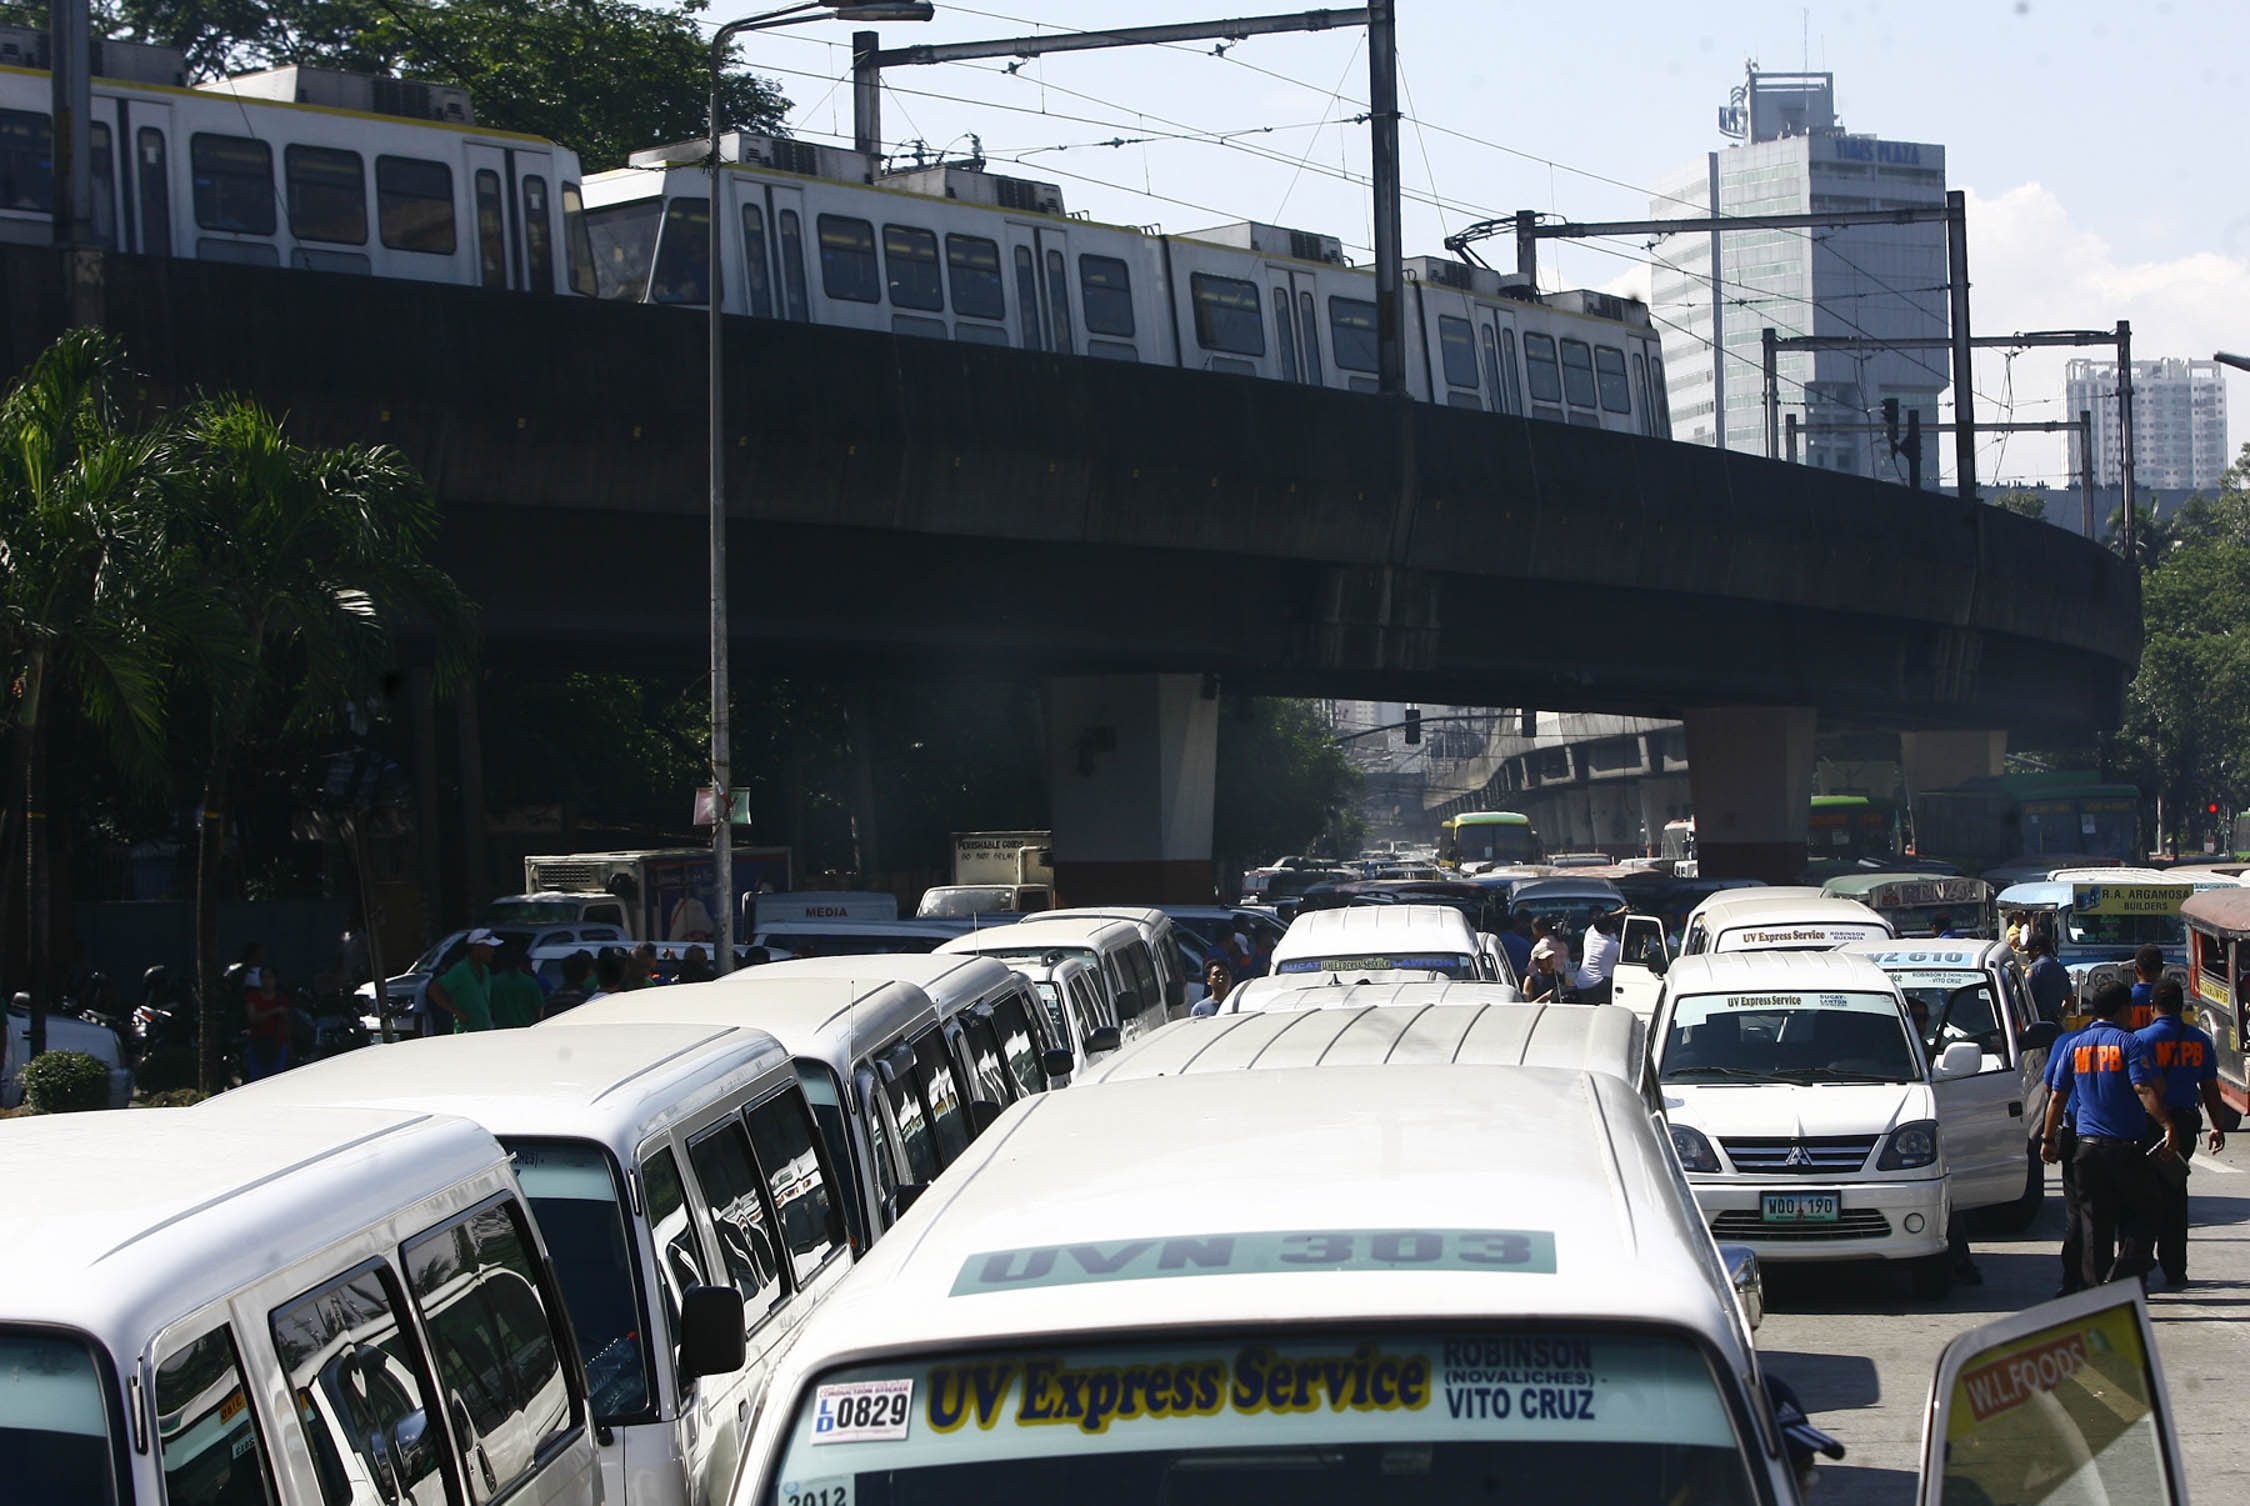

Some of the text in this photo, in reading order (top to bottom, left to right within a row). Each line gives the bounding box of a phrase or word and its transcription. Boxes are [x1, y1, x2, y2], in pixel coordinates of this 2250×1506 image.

[1878, 142, 1919, 164] PLAZA
[2102, 888, 2190, 899] R.A. ARGAMOSA
[806, 907, 848, 918] MEDIA
[2123, 901, 2168, 911] BUILDERS
[1743, 929, 1825, 944] UV Express Service
[1728, 995, 1801, 1008] UV Express Service
[1808, 1199, 1832, 1213] 190
[978, 1233, 1531, 1284] UVN 303
[1443, 1336, 1592, 1369] ROBINSON
[927, 1344, 1427, 1431] UV Express Service
[1445, 1370, 1595, 1387] (NOVALICHES)
[837, 1393, 907, 1428] 0829
[1445, 1387, 1595, 1421] VITO CRUZ
[788, 1486, 847, 1506] 2012
